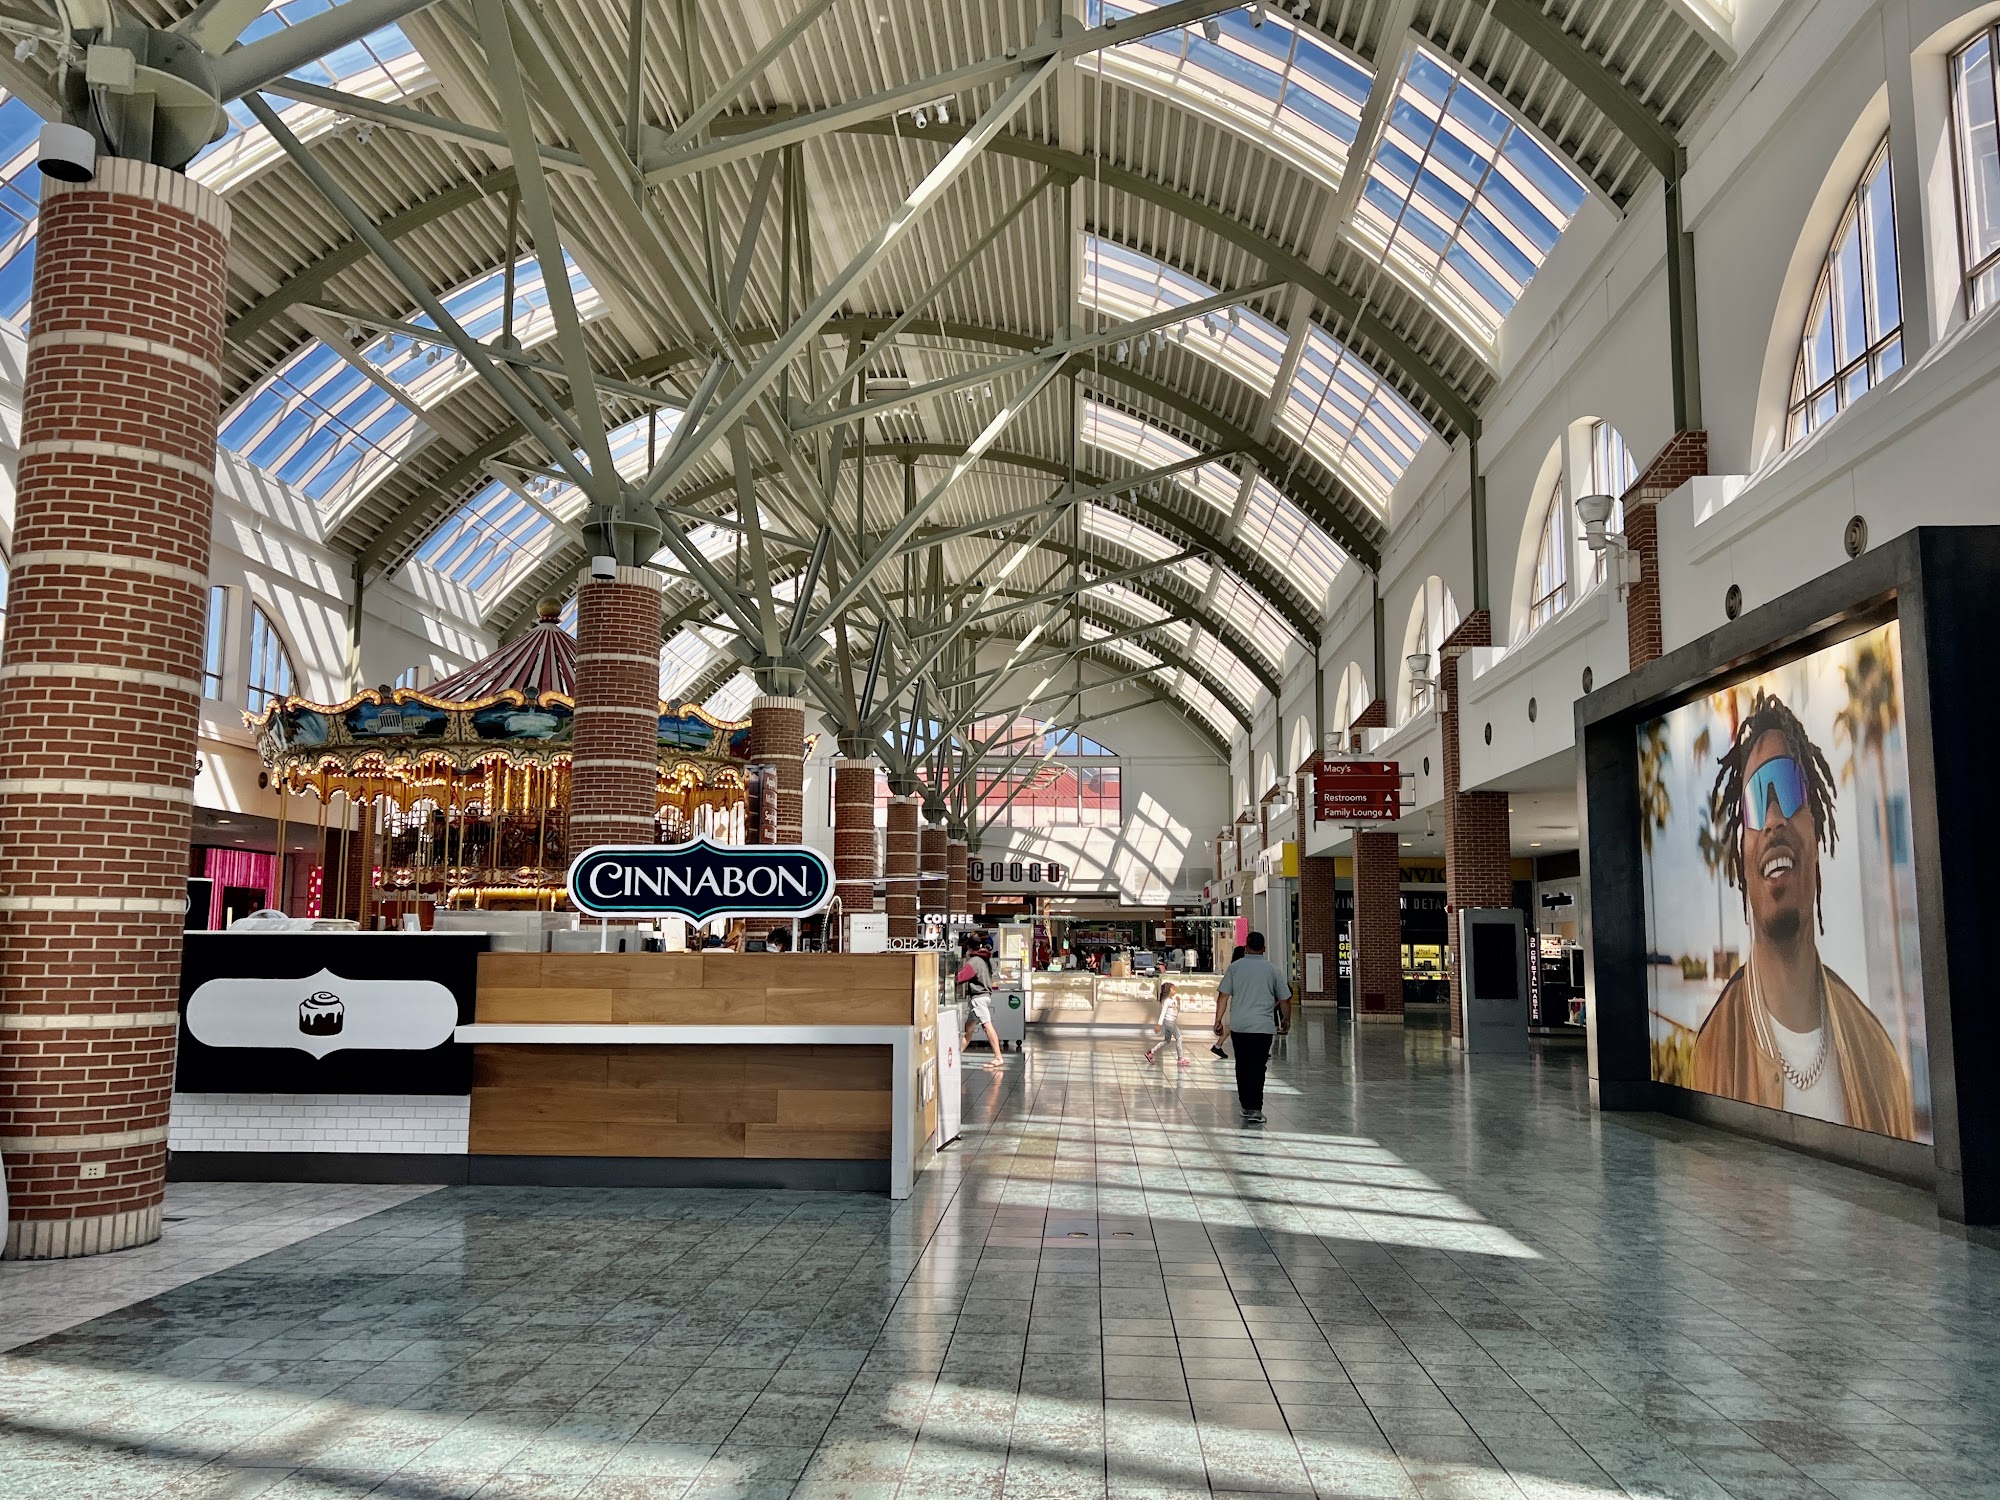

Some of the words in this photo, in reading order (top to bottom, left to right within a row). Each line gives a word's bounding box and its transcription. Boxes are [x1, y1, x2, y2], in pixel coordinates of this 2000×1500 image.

[1323, 764, 1352, 775] Macy's
[1324, 793, 1368, 802] Restrooms
[1324, 808, 1351, 818] Family
[1352, 808, 1383, 819] Lounge
[972, 862, 1060, 882] COURT
[589, 861, 808, 899] CINNABON
[923, 913, 974, 924] COFFEE
